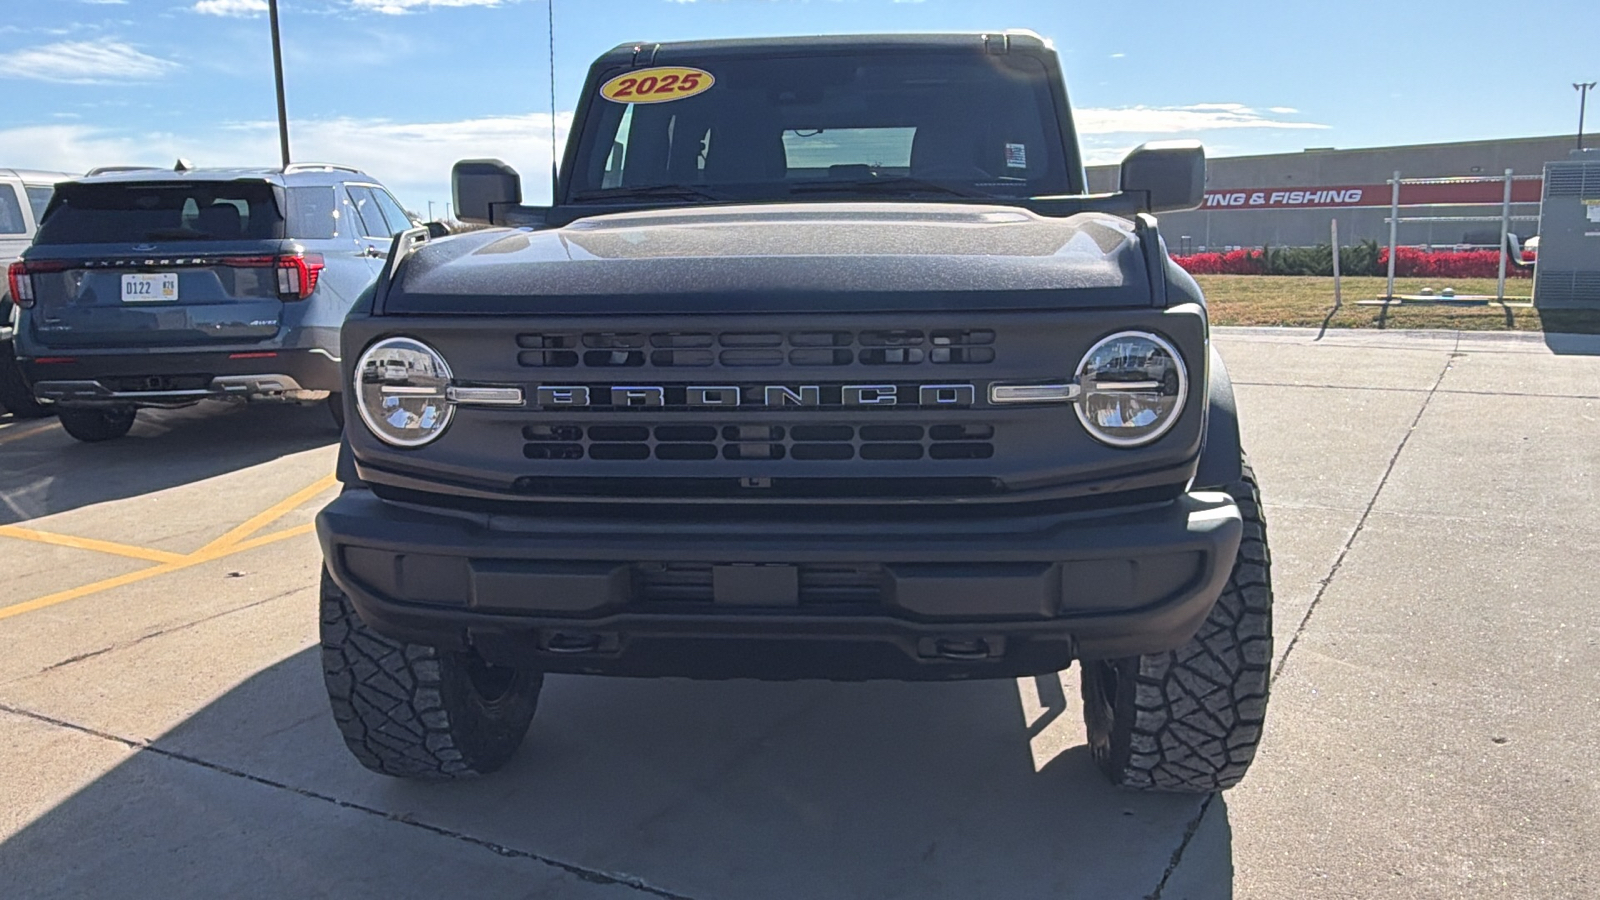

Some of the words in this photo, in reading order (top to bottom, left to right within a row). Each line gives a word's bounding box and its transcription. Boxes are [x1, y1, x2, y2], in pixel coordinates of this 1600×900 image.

[612, 73, 703, 98] 2025
[1249, 192, 1266, 205] &
[1269, 189, 1363, 204] FISHING
[536, 385, 975, 407] BRONCO
